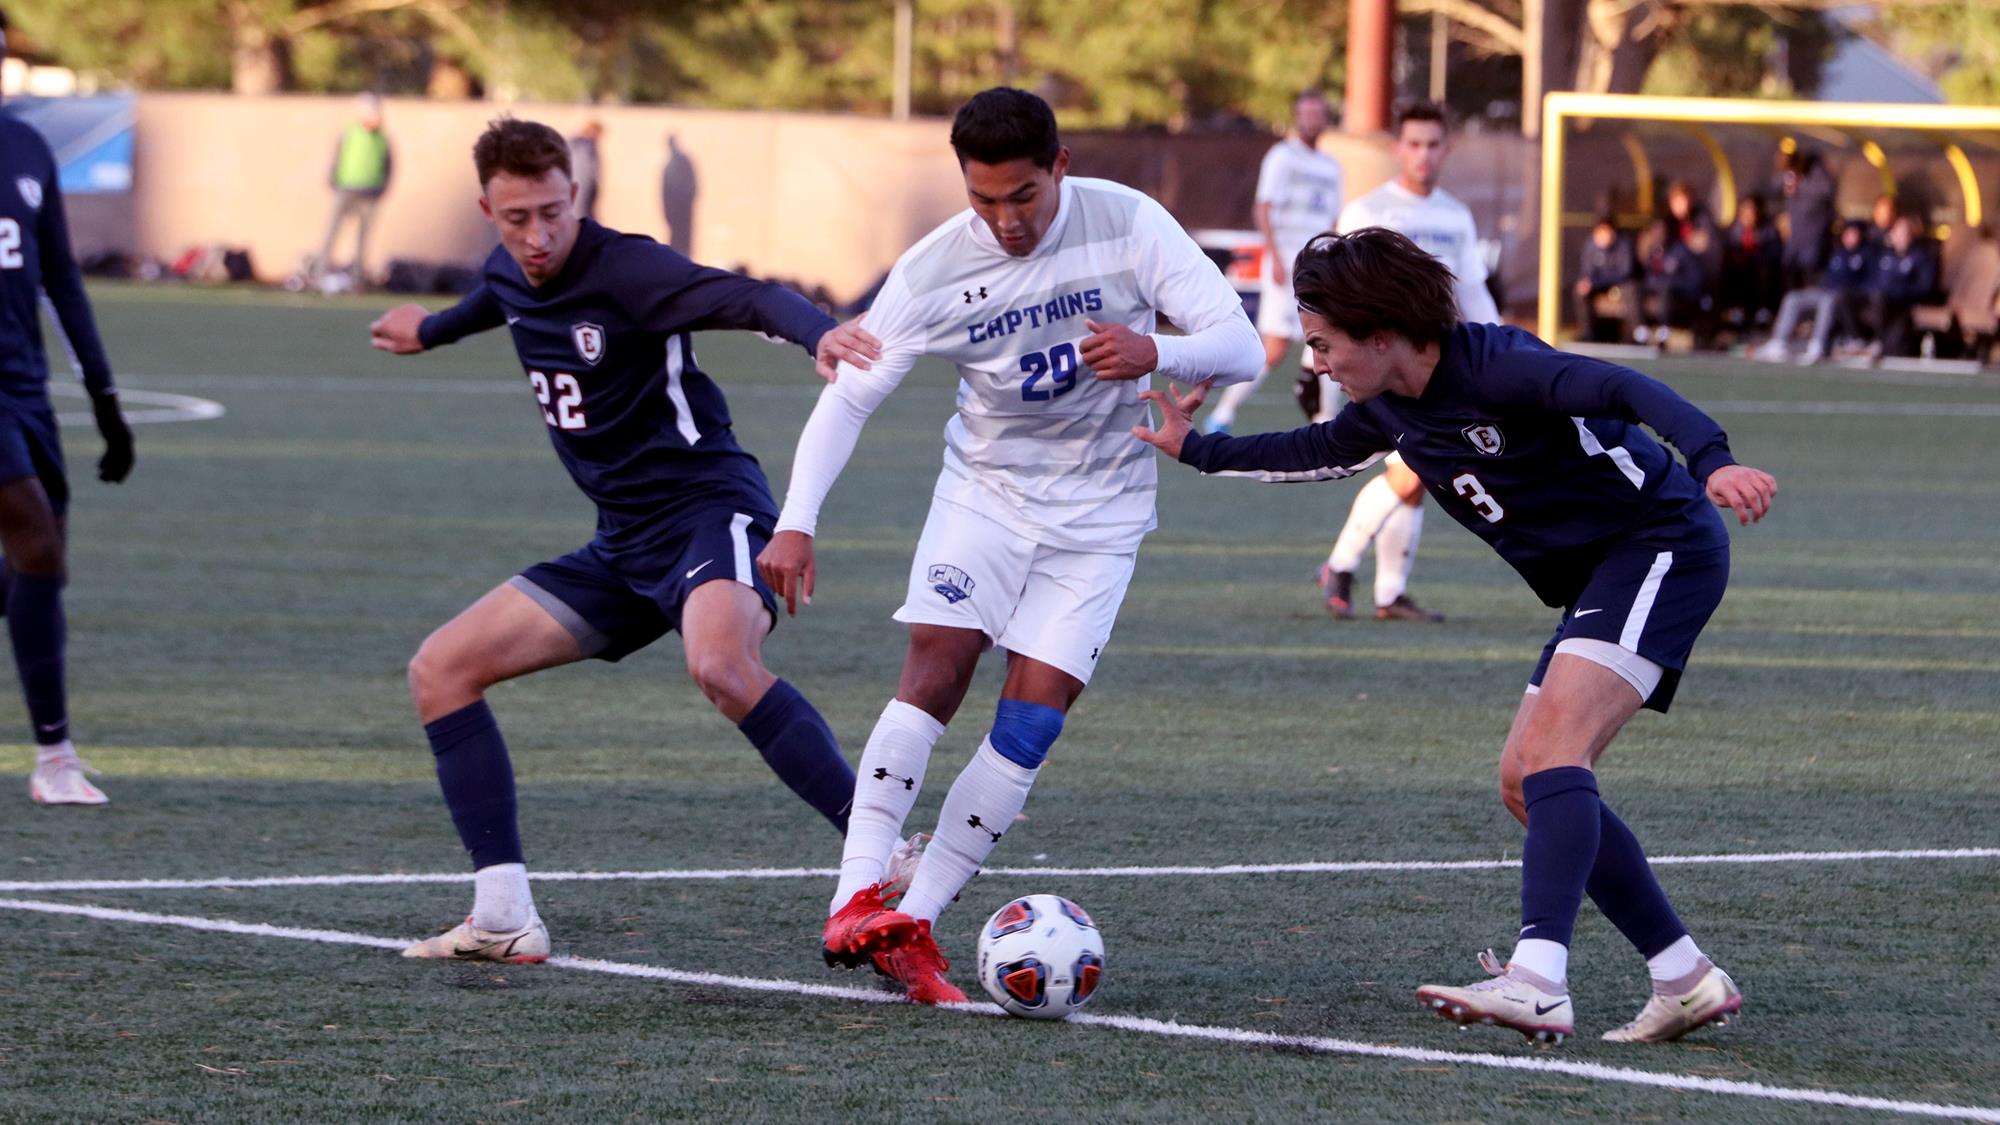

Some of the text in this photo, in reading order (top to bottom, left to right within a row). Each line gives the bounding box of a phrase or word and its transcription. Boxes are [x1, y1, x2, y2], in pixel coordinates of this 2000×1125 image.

[581, 331, 596, 353] E
[966, 287, 1104, 344] CAPTAINS
[1019, 341, 1078, 402] 29
[528, 370, 588, 430] 22
[1452, 472, 1505, 524] 3
[927, 563, 976, 599] CNU
